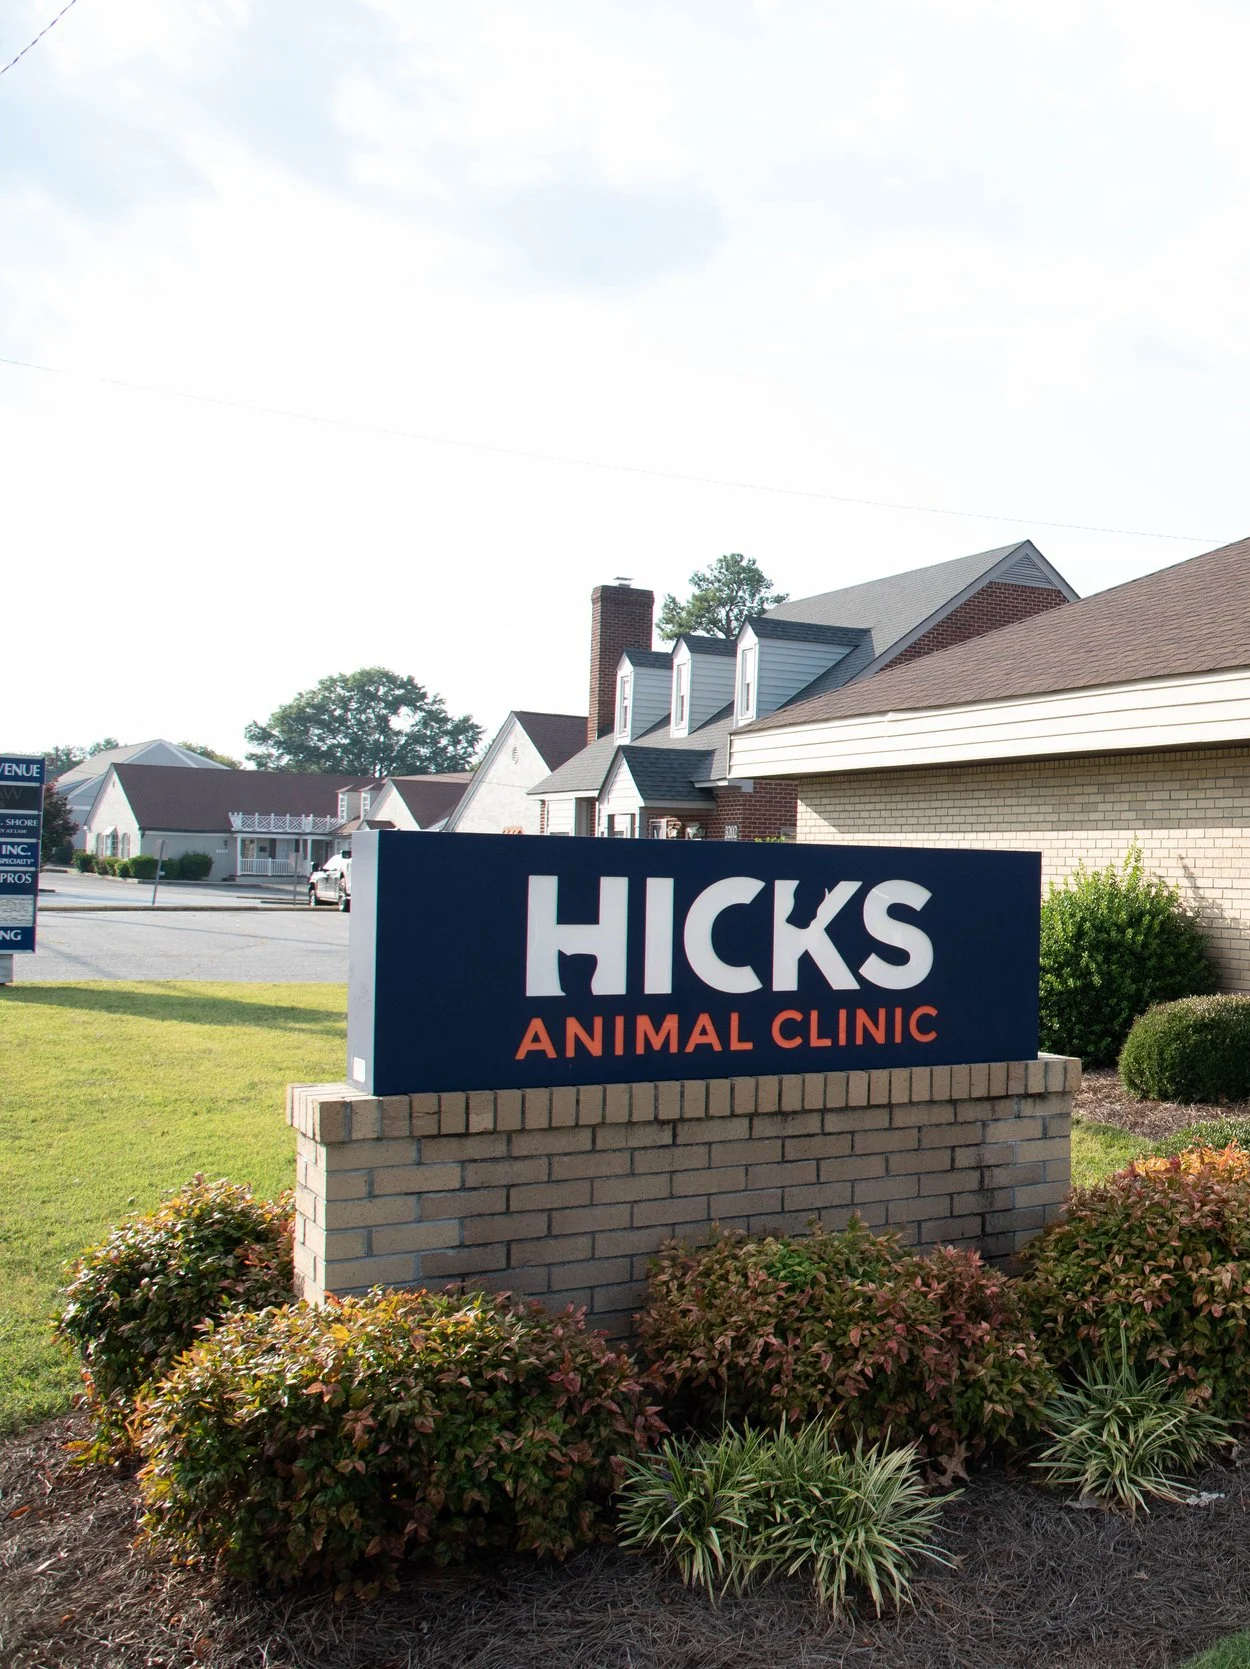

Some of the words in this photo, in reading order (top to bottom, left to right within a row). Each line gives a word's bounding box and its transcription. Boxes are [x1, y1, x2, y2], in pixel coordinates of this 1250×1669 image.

[6, 818, 39, 827] SHORE
[2, 844, 31, 856] INC.
[0, 872, 32, 884] PROS
[526, 875, 934, 997] HICKS
[515, 1012, 754, 1060] ANIMAL
[771, 1005, 938, 1049] CLINIC
